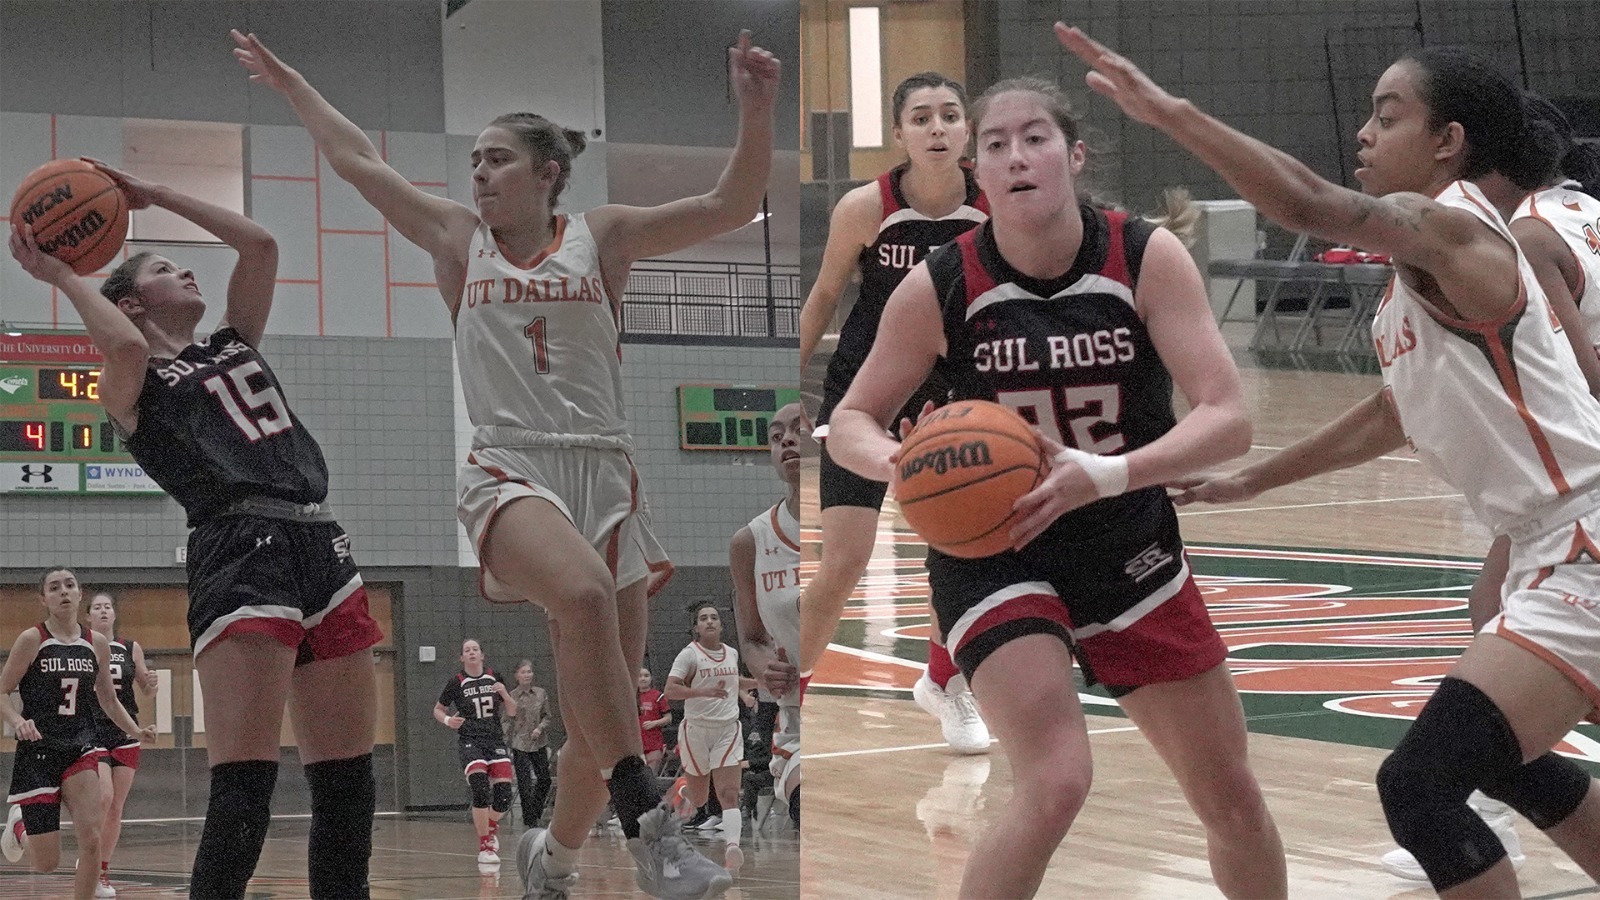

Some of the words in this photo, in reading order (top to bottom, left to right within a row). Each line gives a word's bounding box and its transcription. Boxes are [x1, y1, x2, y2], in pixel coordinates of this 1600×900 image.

[22, 184, 73, 224] NCAA
[878, 243, 916, 269] SUL
[466, 279, 495, 308] UT
[503, 276, 603, 305] DALLAS
[18, 342, 71, 354] UNIVERSITY
[73, 343, 86, 354] OF
[524, 316, 549, 375] 1
[973, 337, 1040, 372] SUL
[1047, 327, 1135, 369] ROSS
[1375, 315, 1416, 368] LAS
[60, 372, 101, 399] 4:2
[202, 360, 293, 443] 15
[26, 424, 44, 449] 4
[83, 427, 91, 447] 1
[105, 468, 146, 477] WYND
[901, 440, 993, 482] Wilson
[762, 570, 787, 592] UT
[40, 657, 66, 673] SUL
[67, 658, 94, 673] ROSS
[699, 668, 712, 678] UT
[58, 677, 79, 716] 3
[463, 687, 478, 698] SUL
[479, 685, 497, 694] ROS
[471, 696, 494, 719] 12
